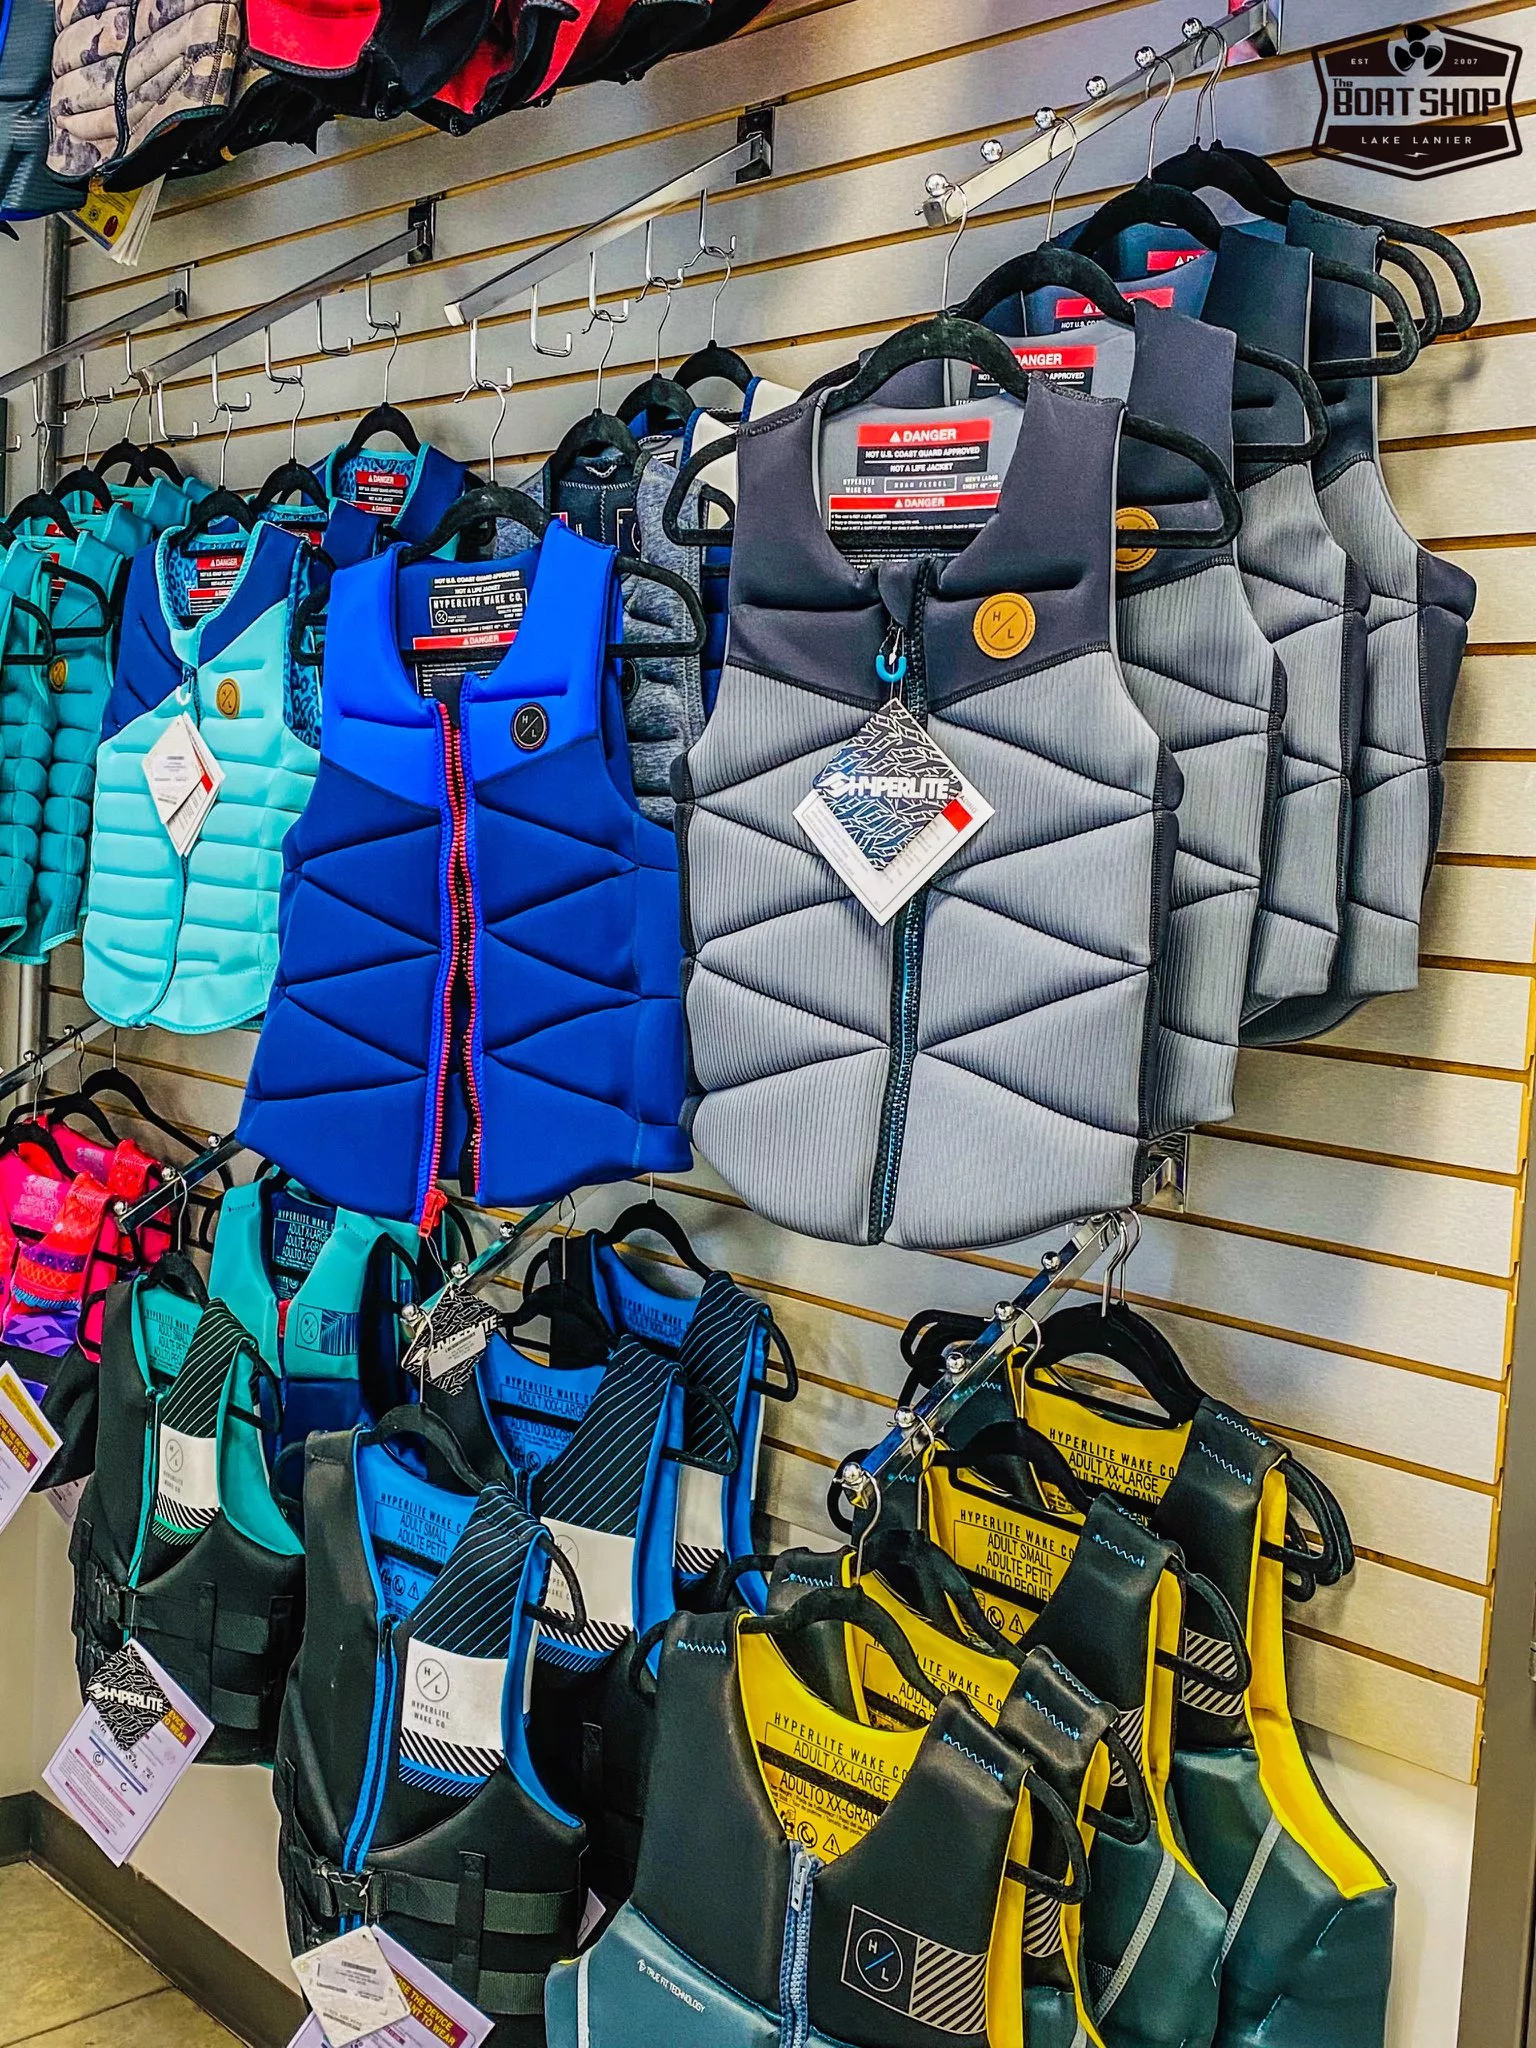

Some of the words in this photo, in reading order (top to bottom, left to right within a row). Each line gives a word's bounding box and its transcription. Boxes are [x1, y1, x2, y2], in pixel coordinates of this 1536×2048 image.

[1049, 371, 1085, 381] APPROVED
[903, 428, 957, 443] DANGER
[865, 451, 879, 459] NOT
[880, 450, 893, 458] U.S.
[894, 450, 918, 458] COAST
[918, 448, 942, 457] GUARD
[942, 446, 981, 456] APPROVED
[373, 476, 395, 484] DANGER
[890, 465, 904, 473] NOT
[904, 464, 911, 472] A
[911, 464, 926, 472] LIFE
[926, 462, 954, 472] JACKET
[904, 497, 945, 508] DANGER
[215, 558, 238, 566] DANGER
[433, 597, 481, 609] HYPERLITE
[483, 594, 506, 605] WAKE
[469, 635, 499, 645] DANGER
[848, 776, 950, 800] HYPERLITE
[1049, 1428, 1116, 1460] HYPERLITE
[1121, 1452, 1153, 1473] WAKE
[1069, 1451, 1103, 1475] ADULT
[1104, 1462, 1159, 1494] XX-LARGE
[380, 1492, 426, 1519] HYPERLITE
[429, 1510, 452, 1529] WAKE
[400, 1512, 423, 1533] ADULT
[424, 1522, 448, 1546] SMALL
[960, 1509, 1021, 1538] HYPERLITE
[1025, 1529, 1055, 1552] WAKE
[398, 1528, 425, 1551] ADULTE
[426, 1538, 448, 1558] PETIT
[987, 1533, 1018, 1556] ADULT
[1020, 1543, 1052, 1571] SMALL
[986, 1550, 1023, 1577] ADULTE
[1025, 1563, 1053, 1588] PETIT
[948, 1669, 980, 1697] WAKE
[103, 1691, 164, 1713] HYPERLITE
[411, 1700, 450, 1719] HYPERLITE
[169, 1709, 187, 1730] EVICE
[413, 1712, 432, 1725] WAKE
[170, 1722, 187, 1743] WEAR
[774, 1712, 844, 1755] HYPERLITE
[850, 1747, 885, 1773] WAKE
[793, 1740, 831, 1772] ADULT
[832, 1757, 890, 1797] XX-LARGE
[780, 1771, 824, 1805] ADULTO
[646, 1966, 660, 1983] TRUE
[660, 1975, 669, 1988] FIT
[669, 1982, 706, 2013] TECHNOLOGY
[409, 1988, 427, 2008] THE
[424, 2002, 454, 2031] DEVICE
[421, 2012, 433, 2027] TO
[432, 2020, 457, 2046] WEAR
